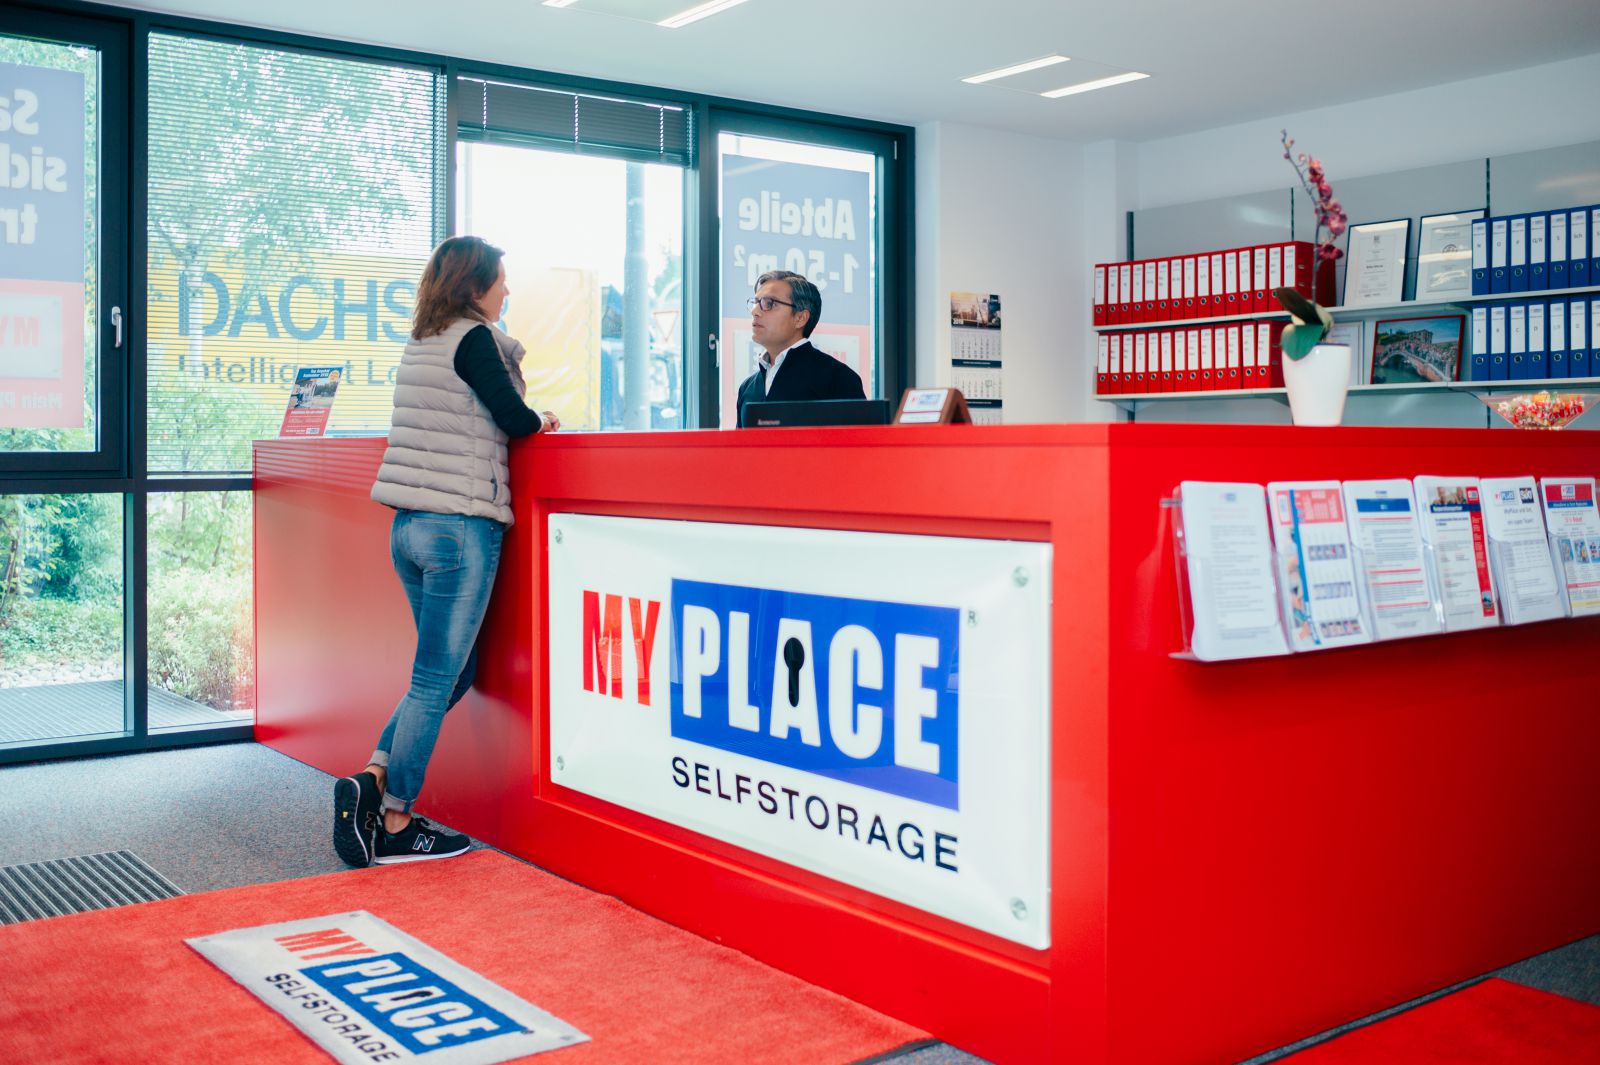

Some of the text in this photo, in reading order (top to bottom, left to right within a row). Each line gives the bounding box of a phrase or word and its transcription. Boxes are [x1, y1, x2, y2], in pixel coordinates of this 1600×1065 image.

[178, 354, 354, 390] Intelligt
[583, 590, 940, 774] MY PLACE
[412, 833, 436, 853] N
[671, 757, 960, 873] SELFSTORAGE
[264, 972, 401, 1063] SELFSTORAGE
[273, 927, 502, 1046] MY PLACE
